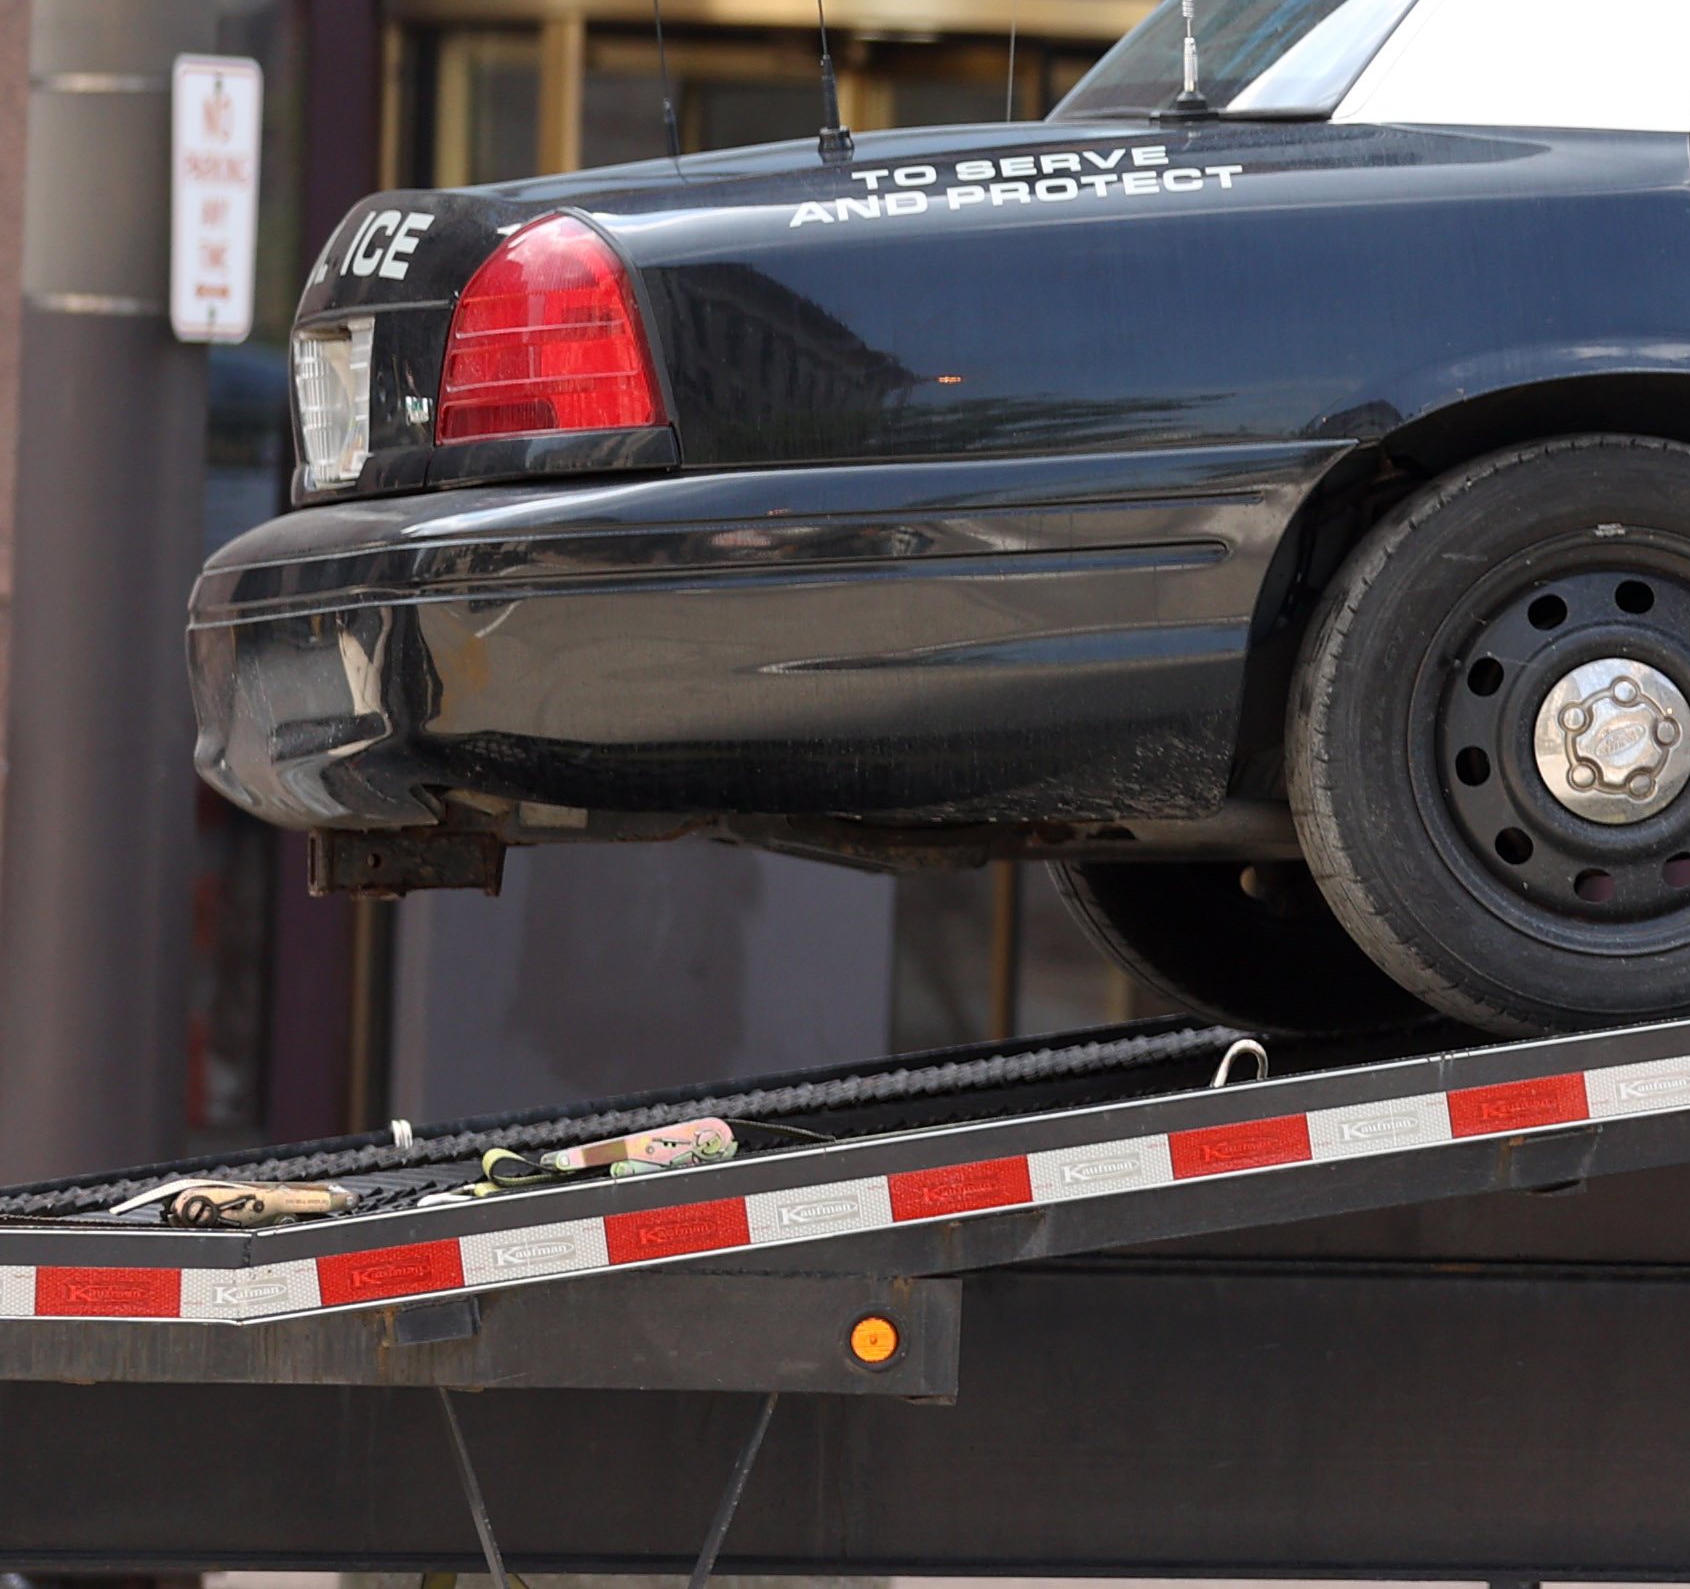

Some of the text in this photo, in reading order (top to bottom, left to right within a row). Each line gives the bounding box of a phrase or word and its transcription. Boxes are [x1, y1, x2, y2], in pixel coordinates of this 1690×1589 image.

[851, 145, 1169, 190] TO SERVE
[789, 165, 1243, 228] AND PROTECT
[1620, 1075, 1690, 1099] Kaufman
[1342, 1115, 1414, 1141] Kaufman
[1063, 1160, 1135, 1184] Kaufman
[781, 1199, 853, 1226] Kaufman
[494, 1242, 569, 1266] Kaufman
